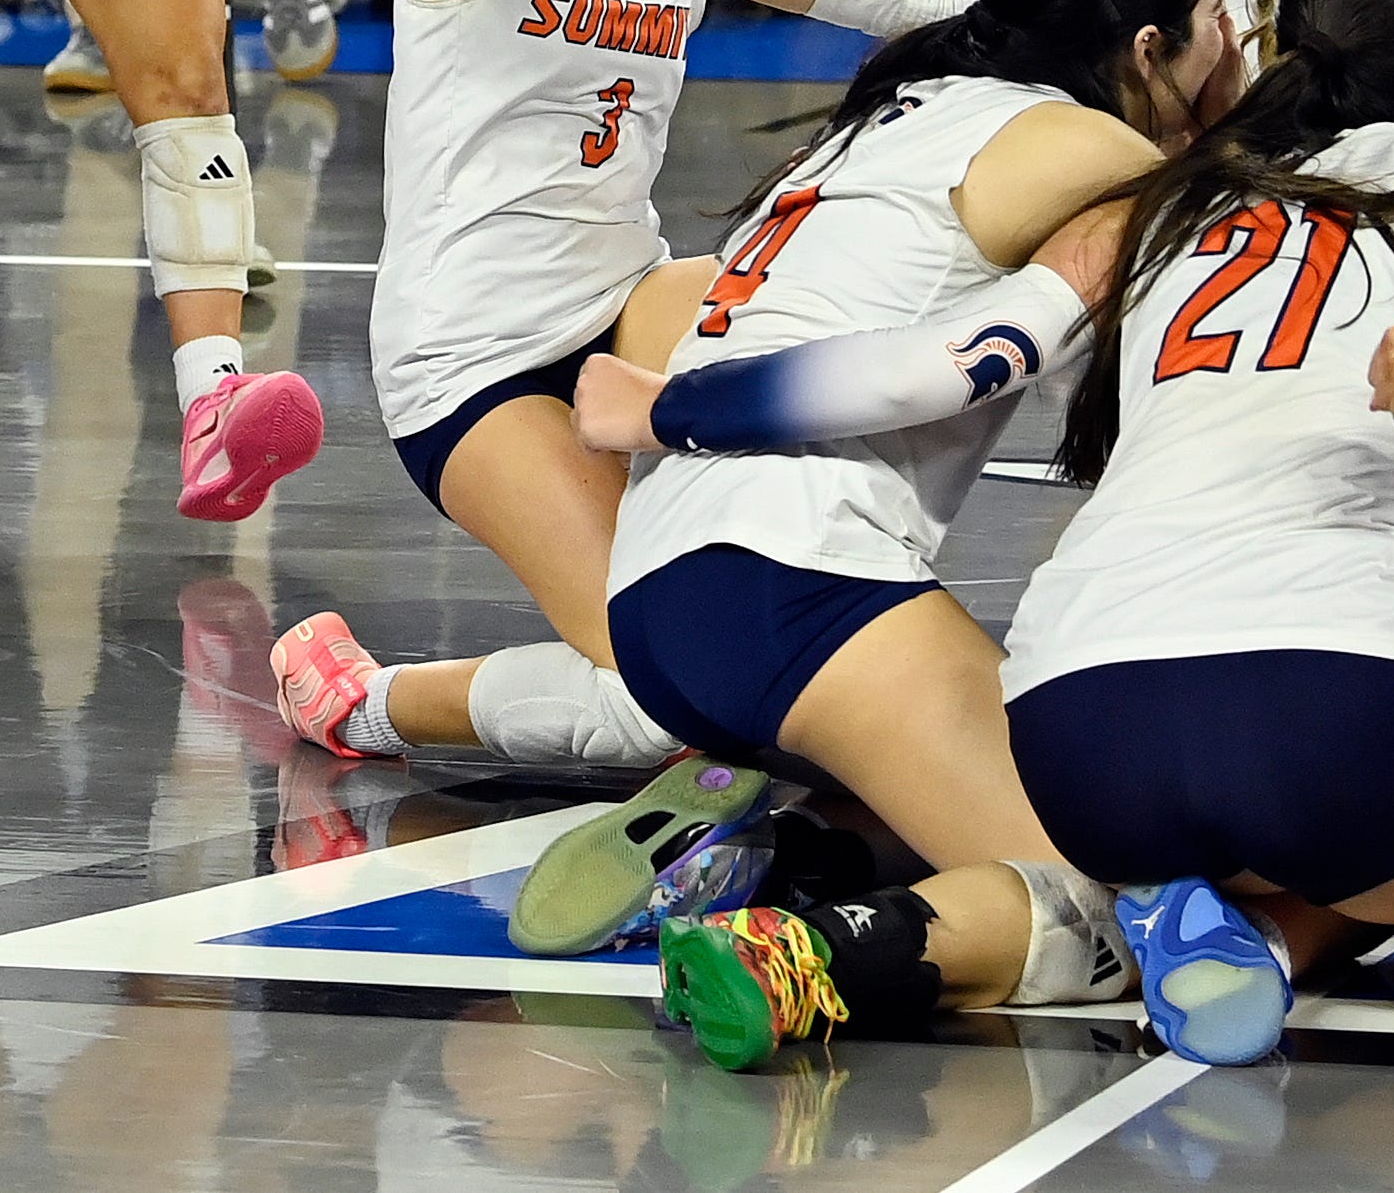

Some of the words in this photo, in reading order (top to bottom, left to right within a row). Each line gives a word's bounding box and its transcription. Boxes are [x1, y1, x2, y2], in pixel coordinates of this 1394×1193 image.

[581, 77, 635, 168] 3
[697, 183, 824, 338] 4
[1153, 198, 1358, 387] 21
